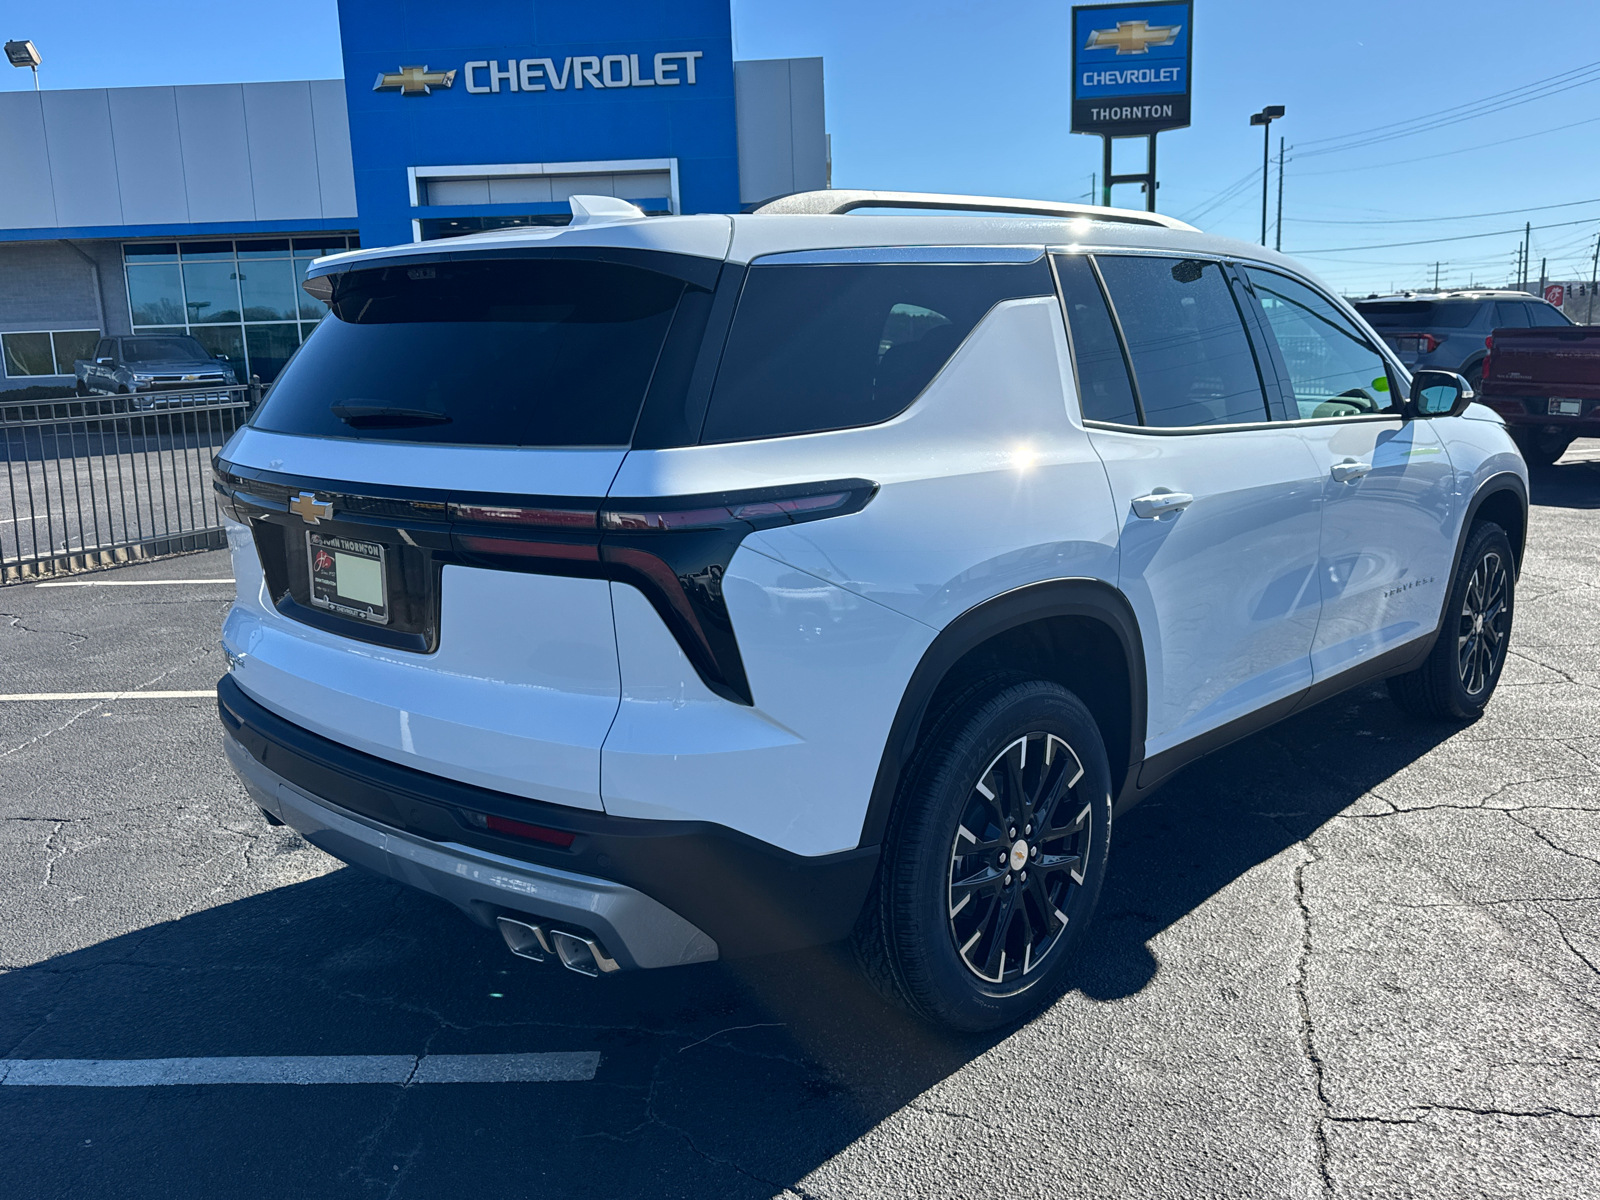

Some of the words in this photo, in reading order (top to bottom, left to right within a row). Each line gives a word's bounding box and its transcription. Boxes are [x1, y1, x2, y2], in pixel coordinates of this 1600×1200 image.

[464, 51, 703, 94] CHEVROLET
[1082, 67, 1181, 86] CHEVROLET
[1091, 104, 1173, 121] THORNTON
[341, 541, 378, 556] THORNTON
[1384, 576, 1436, 598] TRAVERSE
